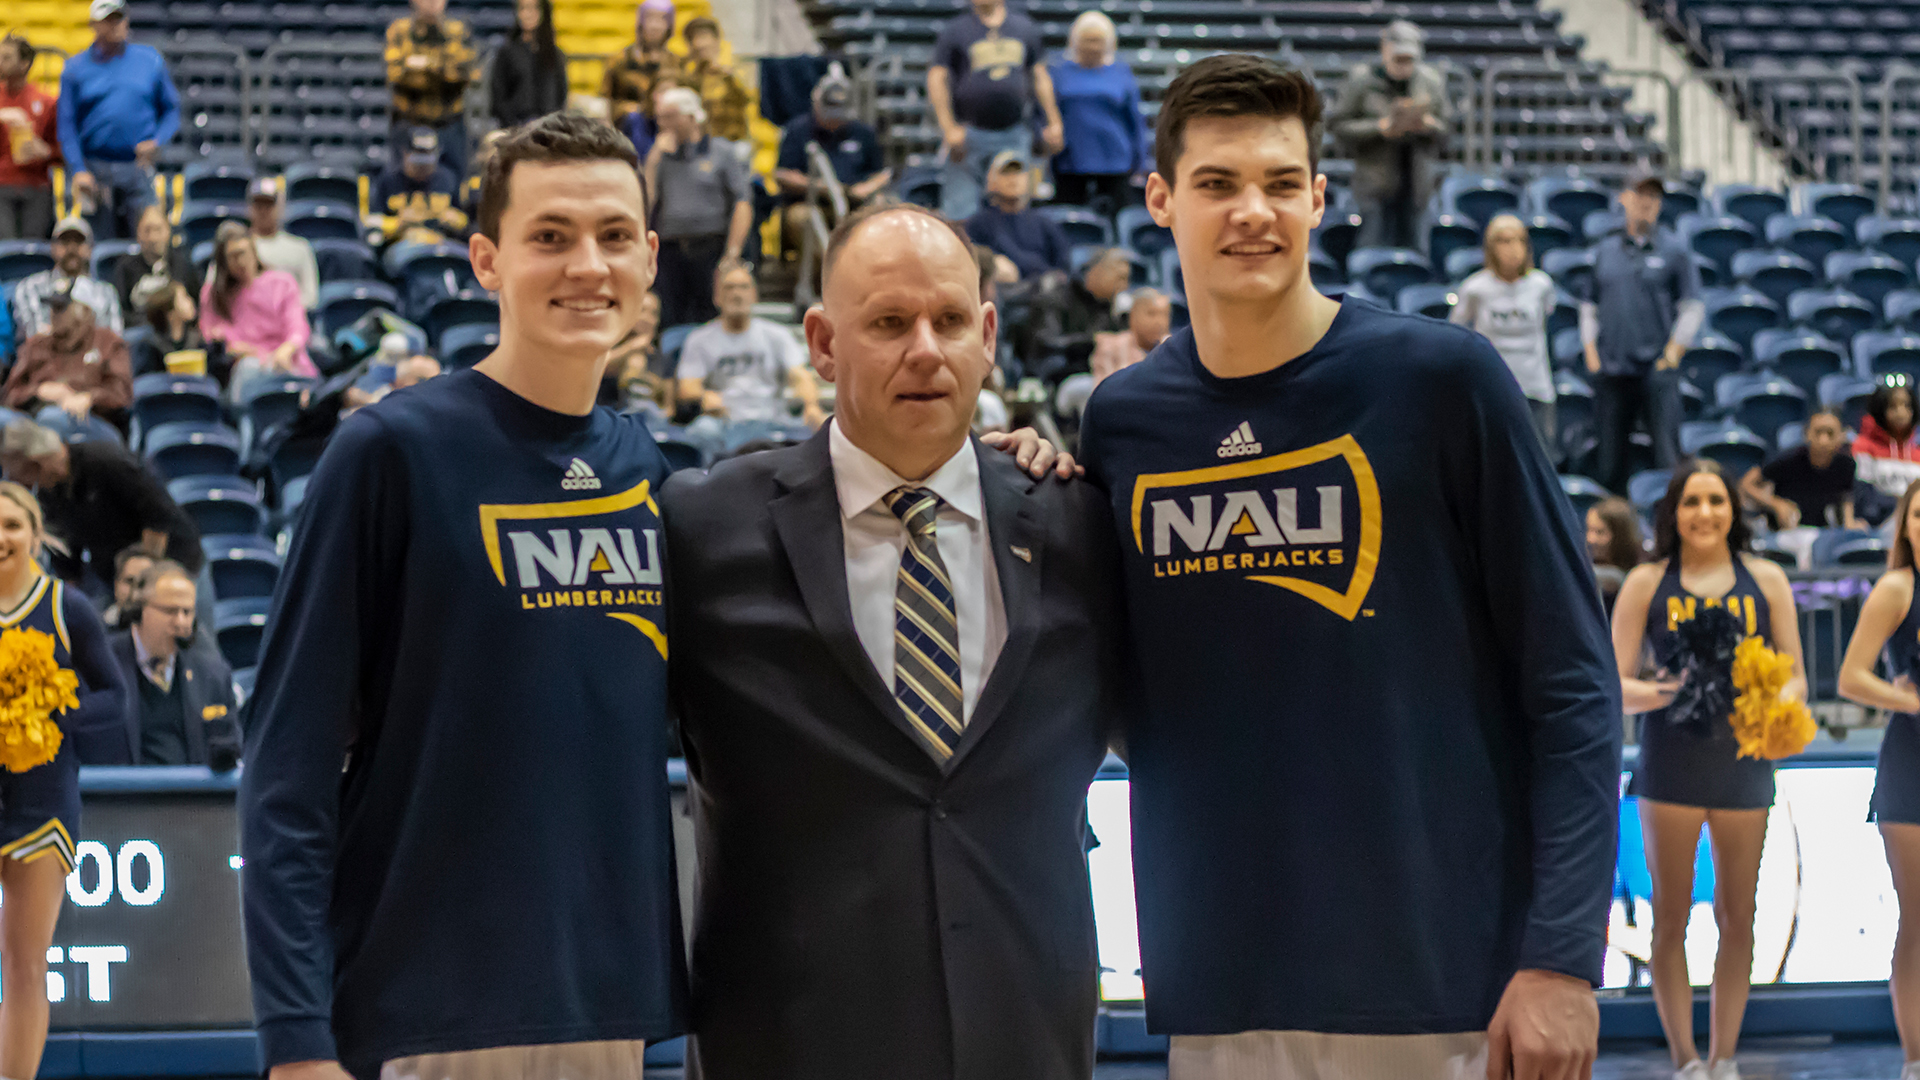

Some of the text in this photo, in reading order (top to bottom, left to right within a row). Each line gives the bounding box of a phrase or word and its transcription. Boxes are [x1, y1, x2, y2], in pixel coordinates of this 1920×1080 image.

[1217, 442, 1263, 458] adidas
[561, 477, 602, 490] adidas
[1151, 485, 1343, 556] NAU
[507, 528, 662, 588] NAU
[1154, 549, 1344, 577] LUMBERJACKS
[521, 590, 662, 609] LUMBERJACKS
[1666, 594, 1758, 637] NU
